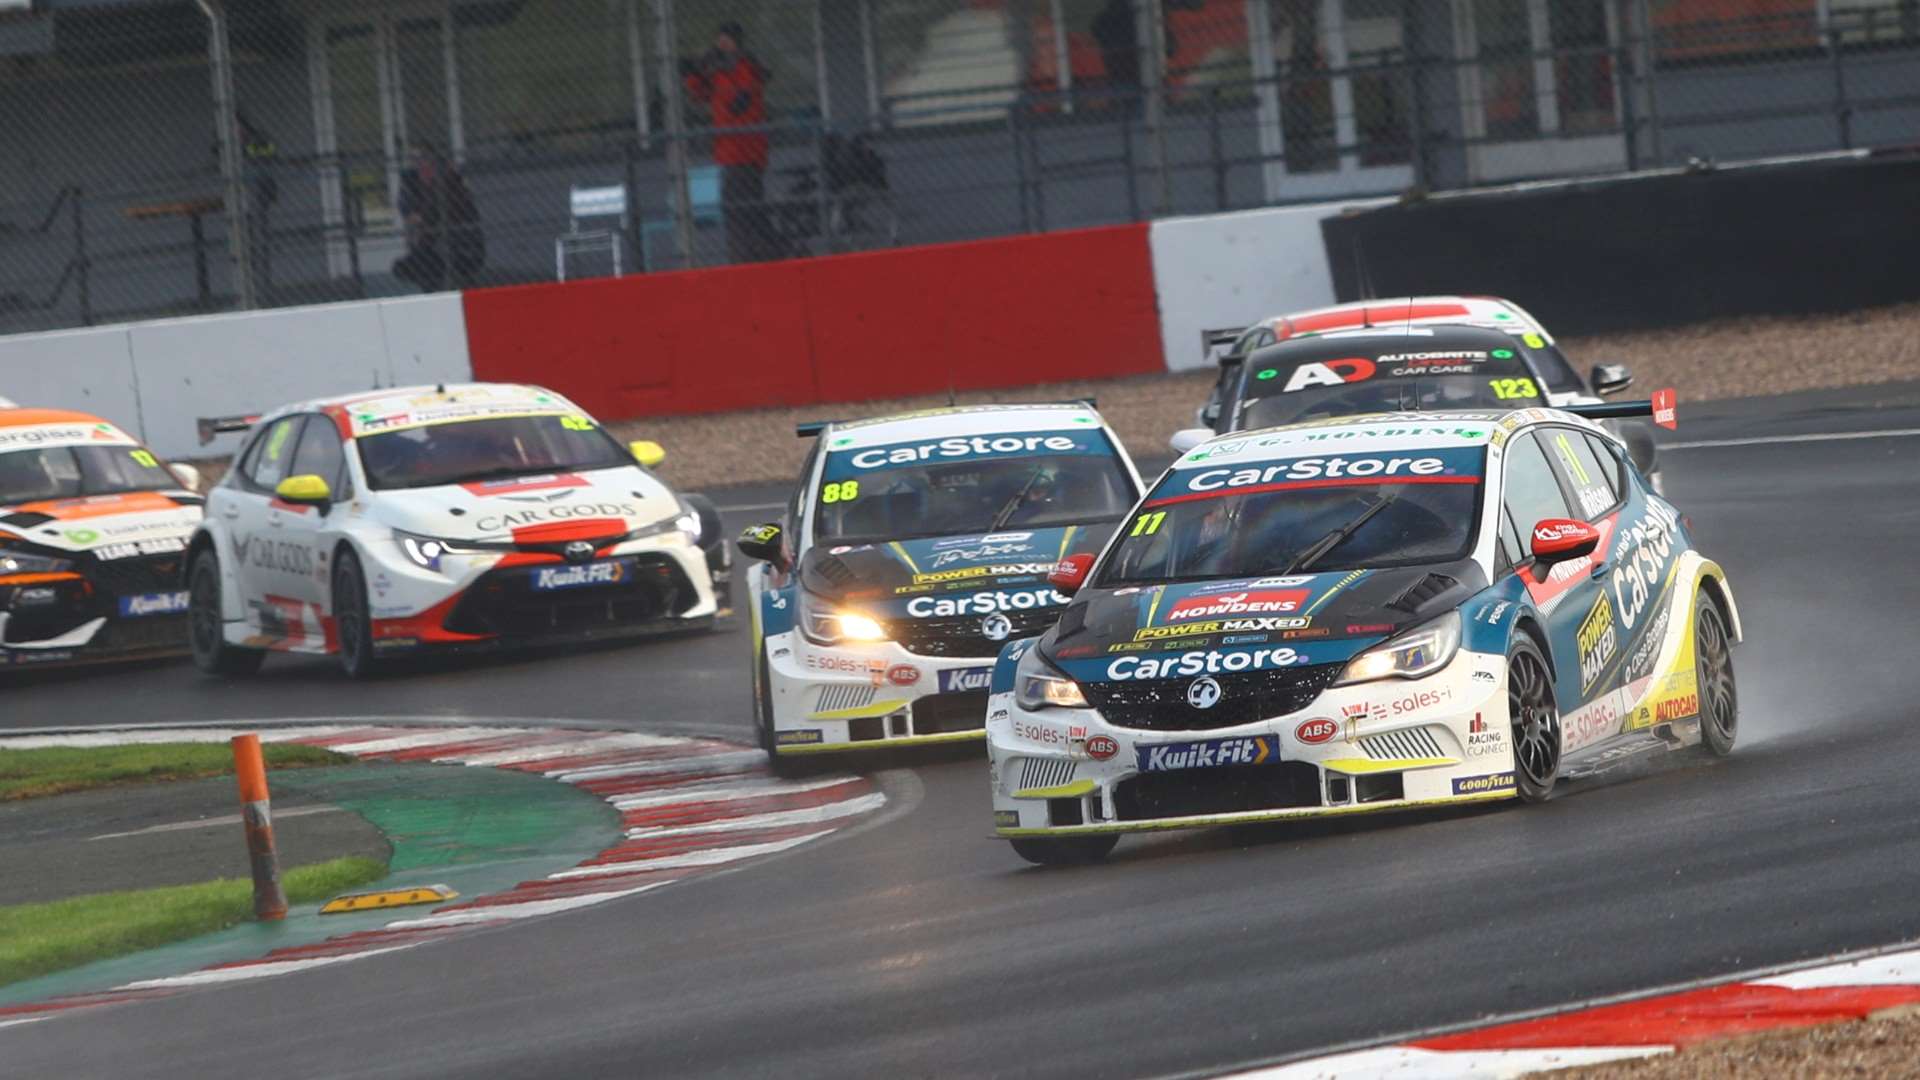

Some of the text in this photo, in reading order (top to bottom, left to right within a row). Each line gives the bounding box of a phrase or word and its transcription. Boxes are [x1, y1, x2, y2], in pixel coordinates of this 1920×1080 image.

[1523, 333, 1545, 349] 6
[1392, 365, 1473, 376] CAR CARE
[1489, 378, 1539, 400] 123
[1303, 427, 1465, 442] MONDINI
[852, 436, 1075, 469] CarStore
[1188, 457, 1445, 492] CarStore
[823, 480, 859, 503] 88
[477, 503, 637, 532] CAR GODS
[1130, 511, 1167, 537] 11
[918, 567, 987, 582] POWER
[1169, 601, 1297, 621] HOWDENS
[1138, 616, 1306, 638] POWER MAXED
[1579, 603, 1611, 662] POWER
[1107, 648, 1299, 681] CarStore
[1581, 625, 1615, 686] MAXED
[891, 670, 917, 681] ABS
[1392, 685, 1452, 715] sales-i
[1656, 694, 1697, 721] AUTOCAR
[1025, 724, 1069, 744] sales-i
[1302, 722, 1333, 738] ABS
[1468, 732, 1501, 744] RACING
[1089, 741, 1114, 753] ABS
[1467, 742, 1508, 757] CONNECT
[1458, 774, 1515, 791] GOODYEAR
